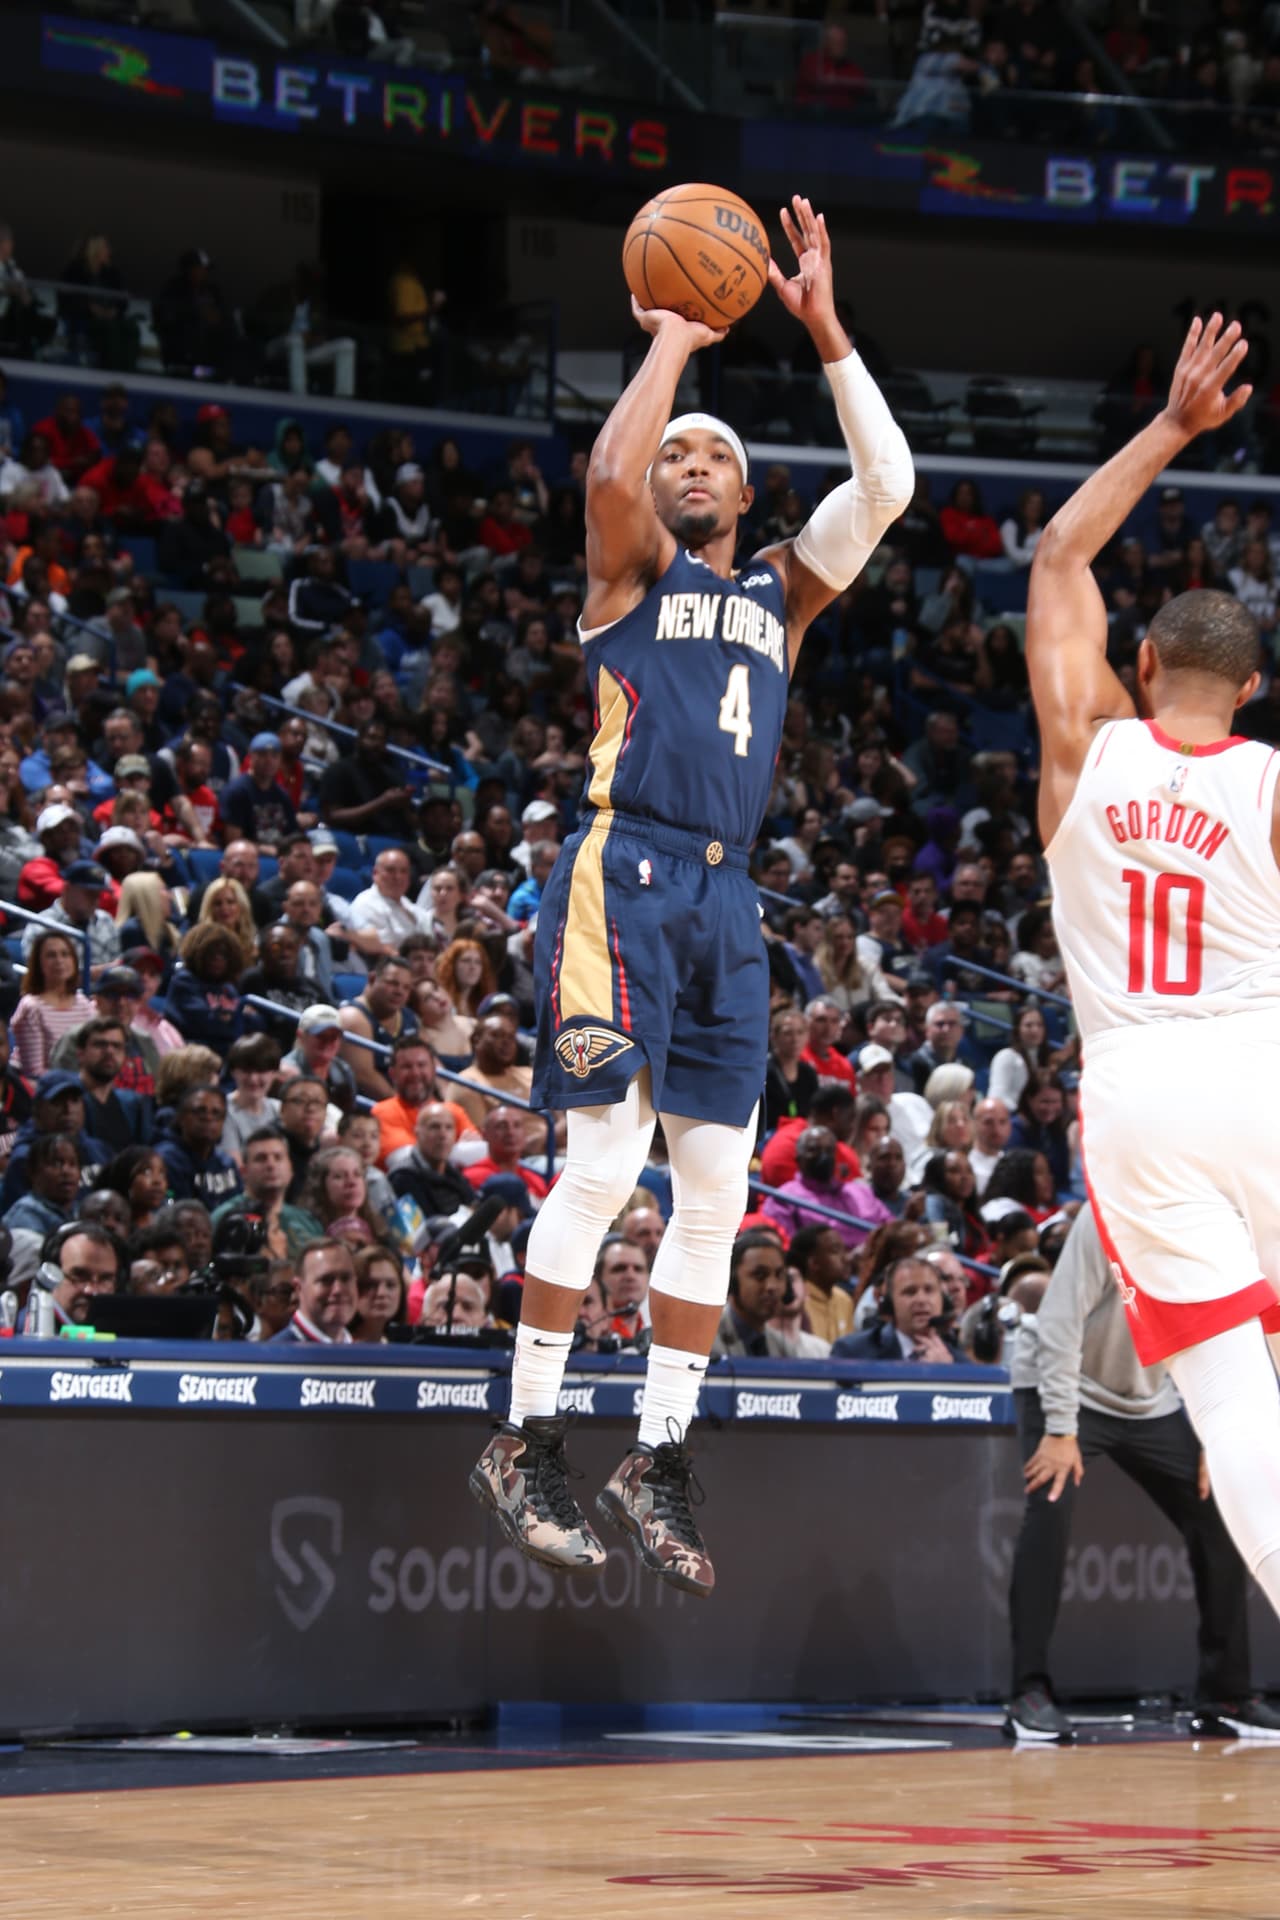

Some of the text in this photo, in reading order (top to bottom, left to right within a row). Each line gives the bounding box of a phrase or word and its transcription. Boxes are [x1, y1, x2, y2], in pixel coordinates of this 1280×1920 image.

[213, 57, 668, 168] BETRIVERS
[1046, 158, 1274, 214] BETR
[714, 206, 769, 264] Wilso
[655, 593, 785, 673] NEW ORLEANS
[718, 664, 752, 757] 4
[1106, 800, 1229, 861] GORDON
[1122, 868, 1205, 996] 10
[50, 1372, 133, 1402] SEATGEEK
[178, 1373, 258, 1405] SEATGEEK
[300, 1378, 375, 1408] SEATGEEK
[417, 1380, 489, 1409] SEATGEEK
[558, 1387, 595, 1414] GEEK
[737, 1391, 801, 1420] SEATGEEK
[836, 1394, 899, 1421] SEATGEEK
[931, 1394, 993, 1422] SEATGEEK
